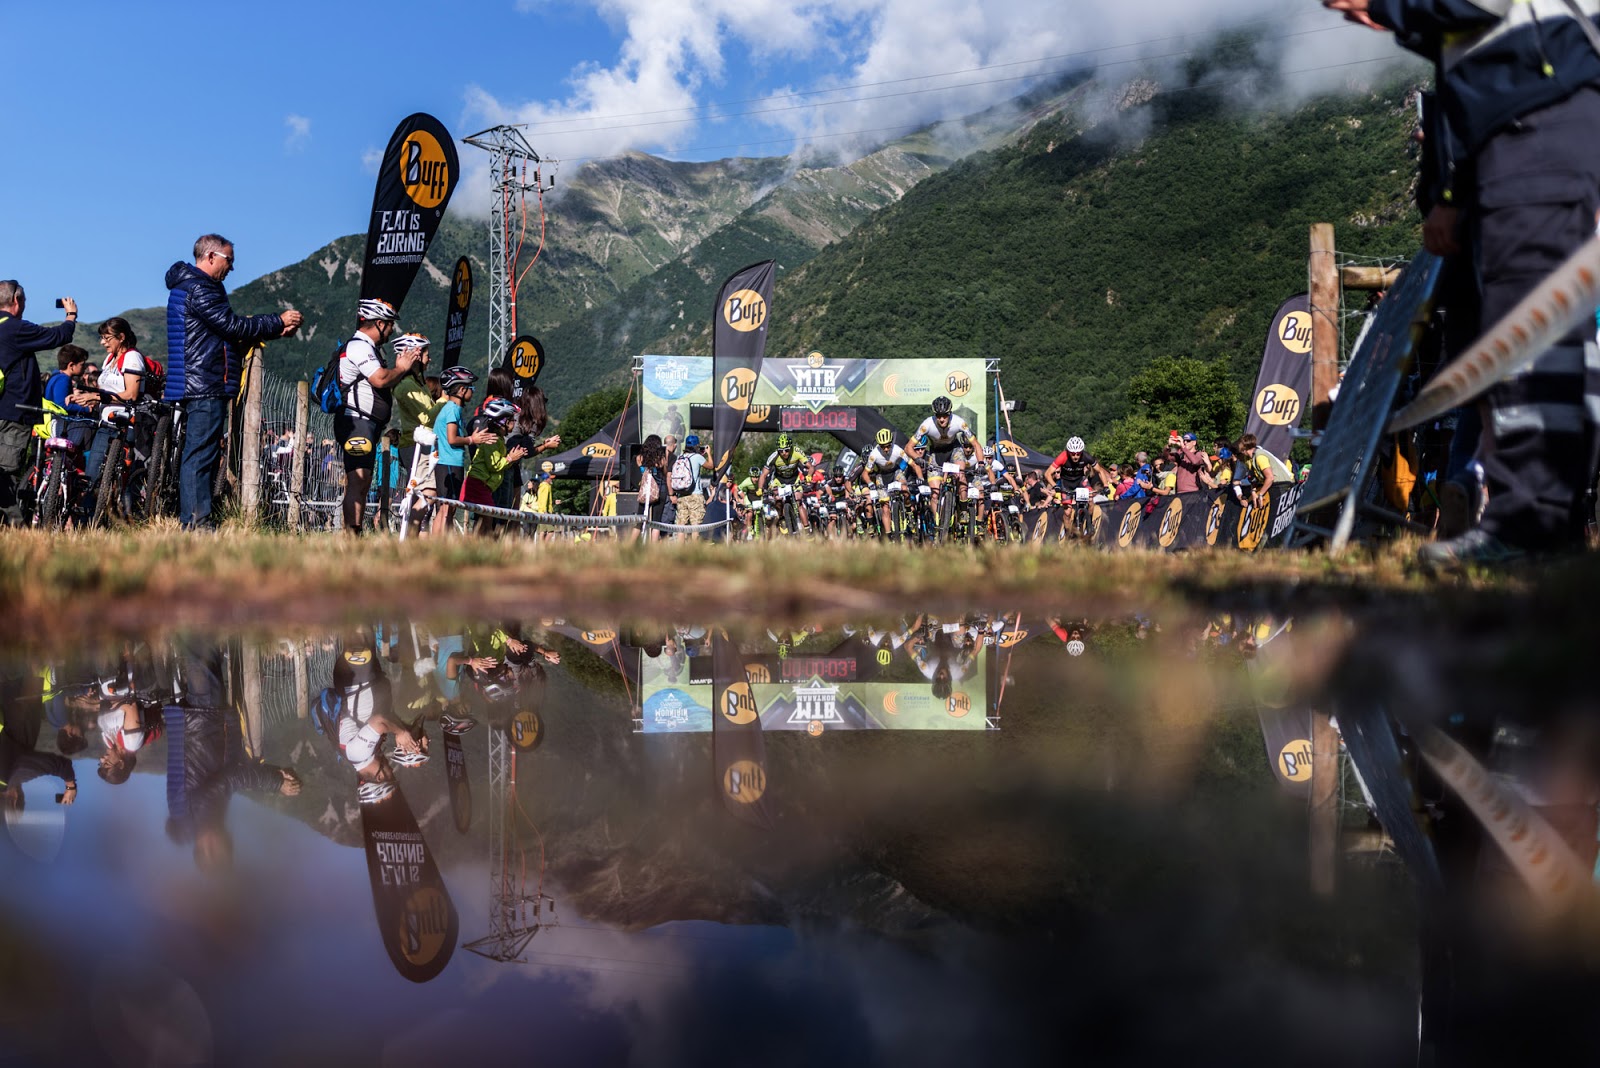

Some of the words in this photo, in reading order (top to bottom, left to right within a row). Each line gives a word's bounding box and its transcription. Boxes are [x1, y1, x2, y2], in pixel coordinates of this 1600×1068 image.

[381, 210, 410, 232] FLAT
[410, 213, 421, 231] IS
[795, 369, 836, 387] MTB
